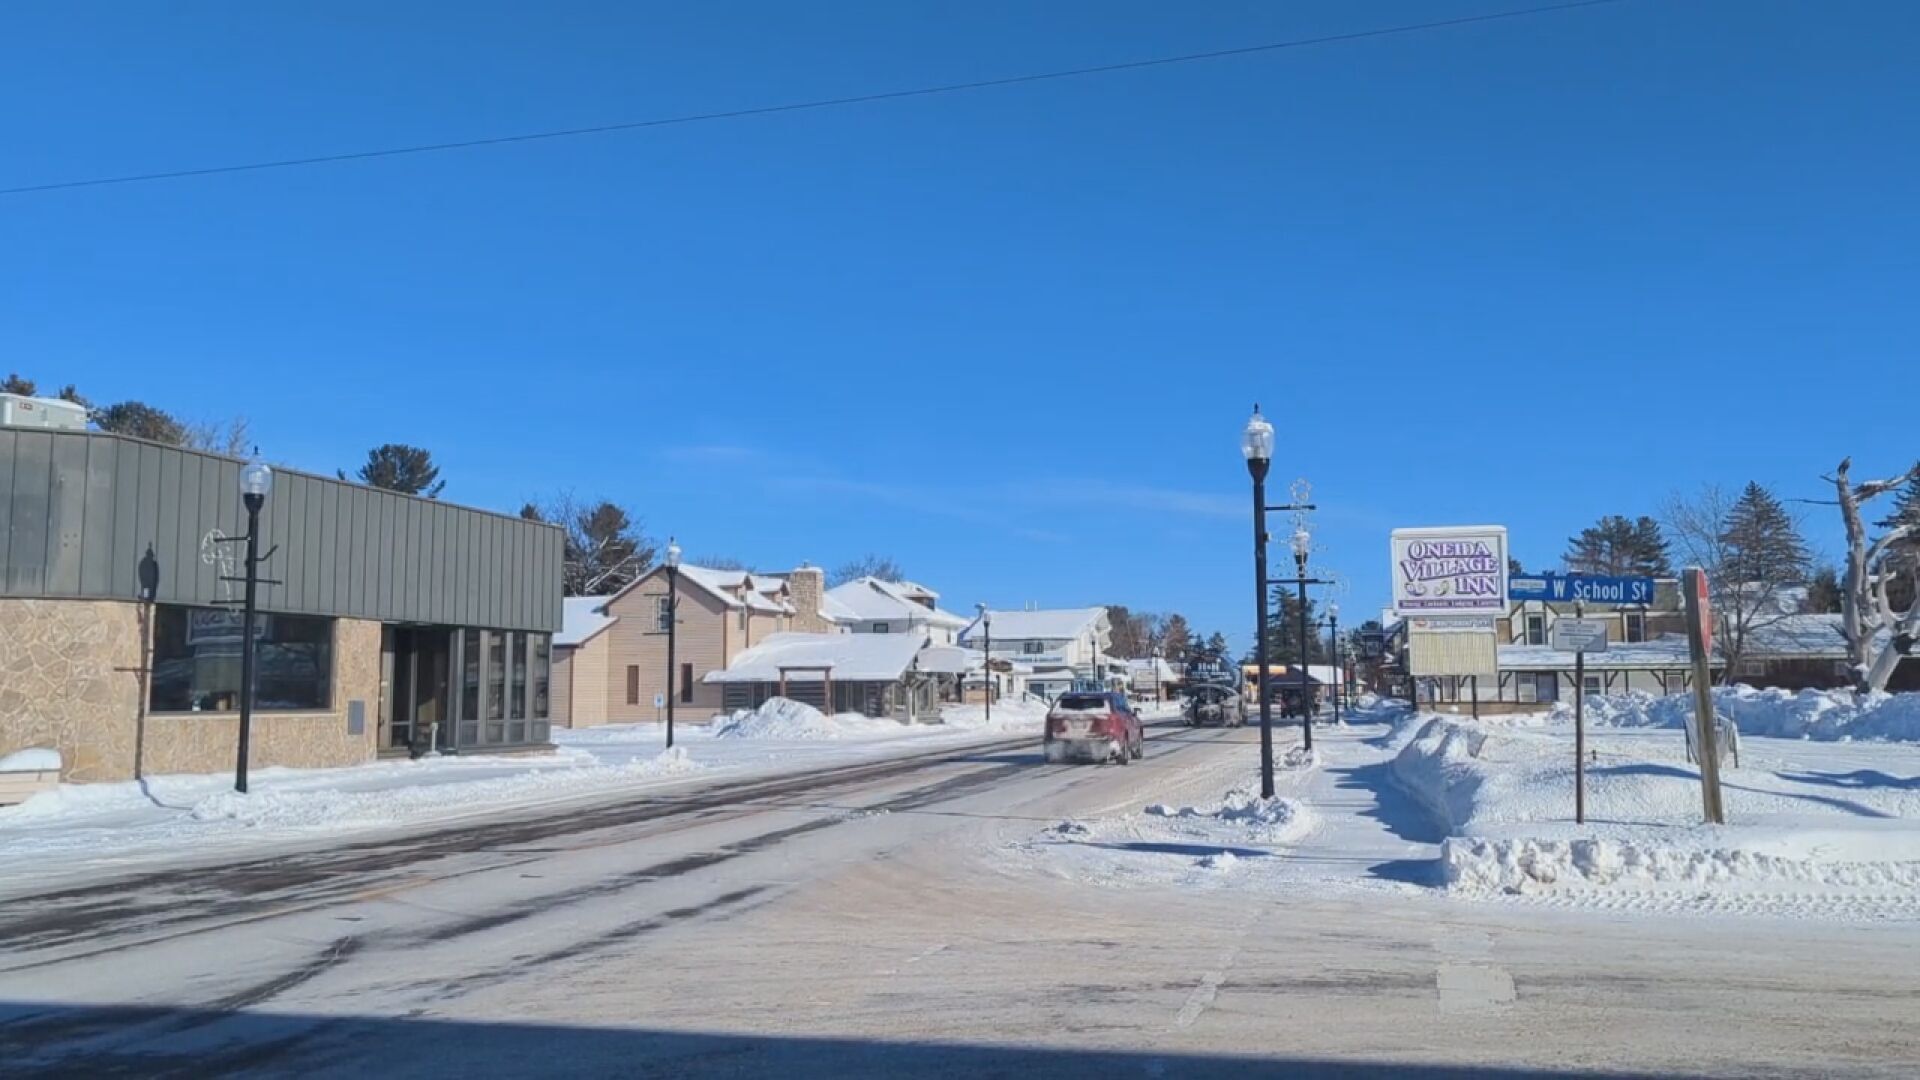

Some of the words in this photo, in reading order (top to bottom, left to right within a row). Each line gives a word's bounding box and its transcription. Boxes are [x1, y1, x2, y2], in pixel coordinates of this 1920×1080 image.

[1408, 540, 1491, 560] ONEIDA
[1400, 558, 1499, 582] VILLAGE
[1455, 576, 1498, 595] INN
[1553, 580, 1566, 598] W
[1574, 580, 1624, 599] School
[1631, 581, 1647, 599] St
